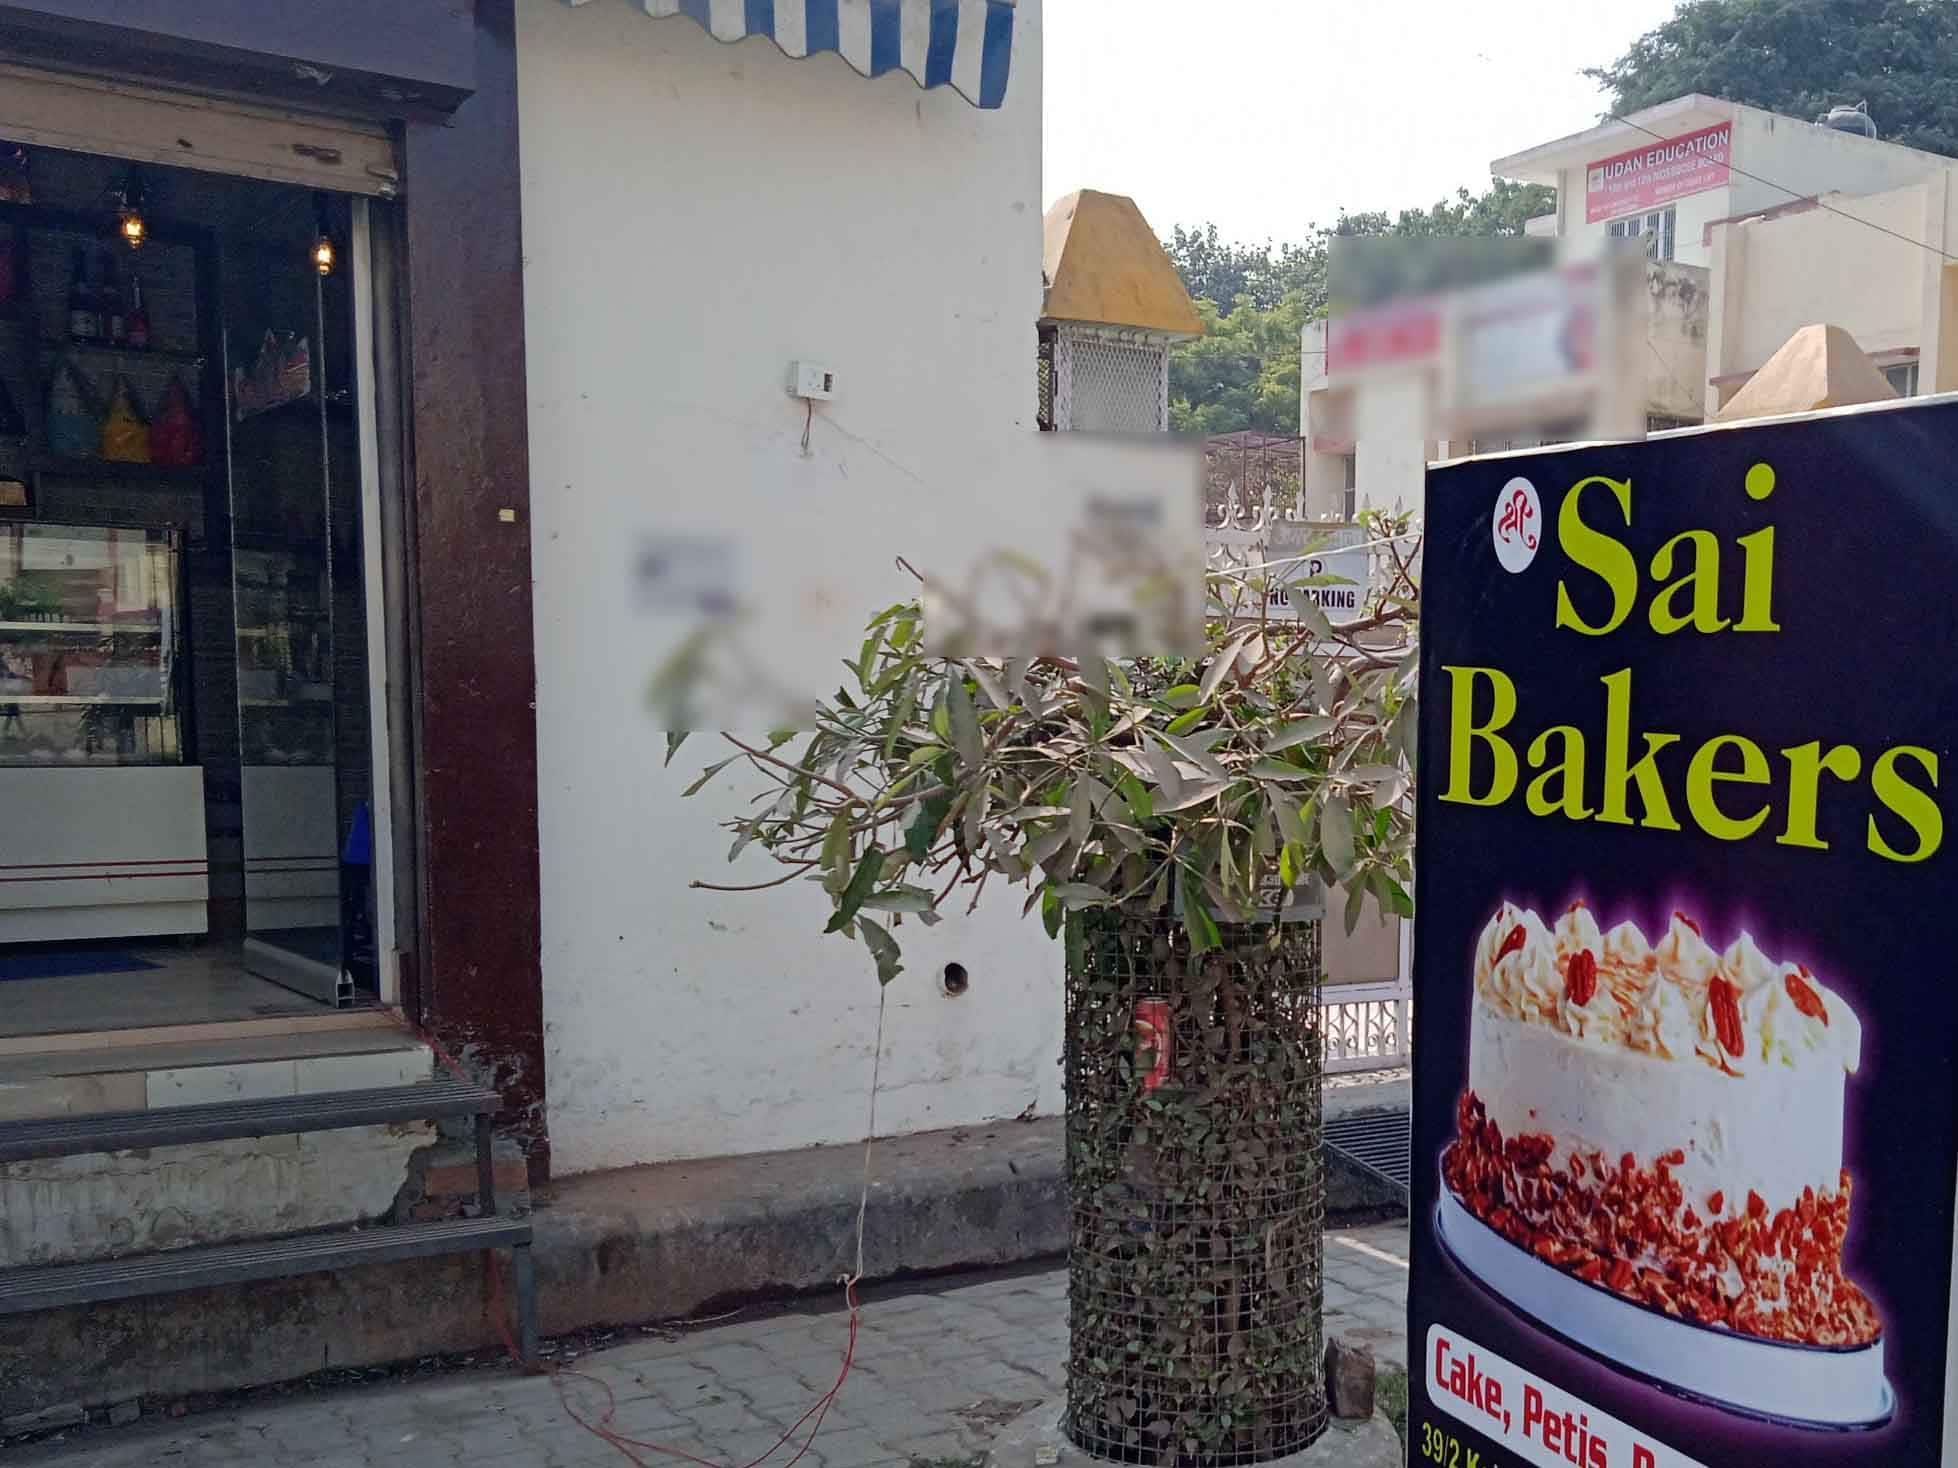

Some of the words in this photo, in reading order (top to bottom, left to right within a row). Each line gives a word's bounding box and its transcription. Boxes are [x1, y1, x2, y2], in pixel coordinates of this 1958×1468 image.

[1605, 155, 1642, 179] UDAN
[1646, 130, 1729, 168] EDUCATION
[1556, 463, 1780, 635] Sai
[1438, 665, 1944, 863] Bakers
[1435, 1337, 1511, 1434] Cake,
[1422, 1422, 1459, 1468] 39/2
